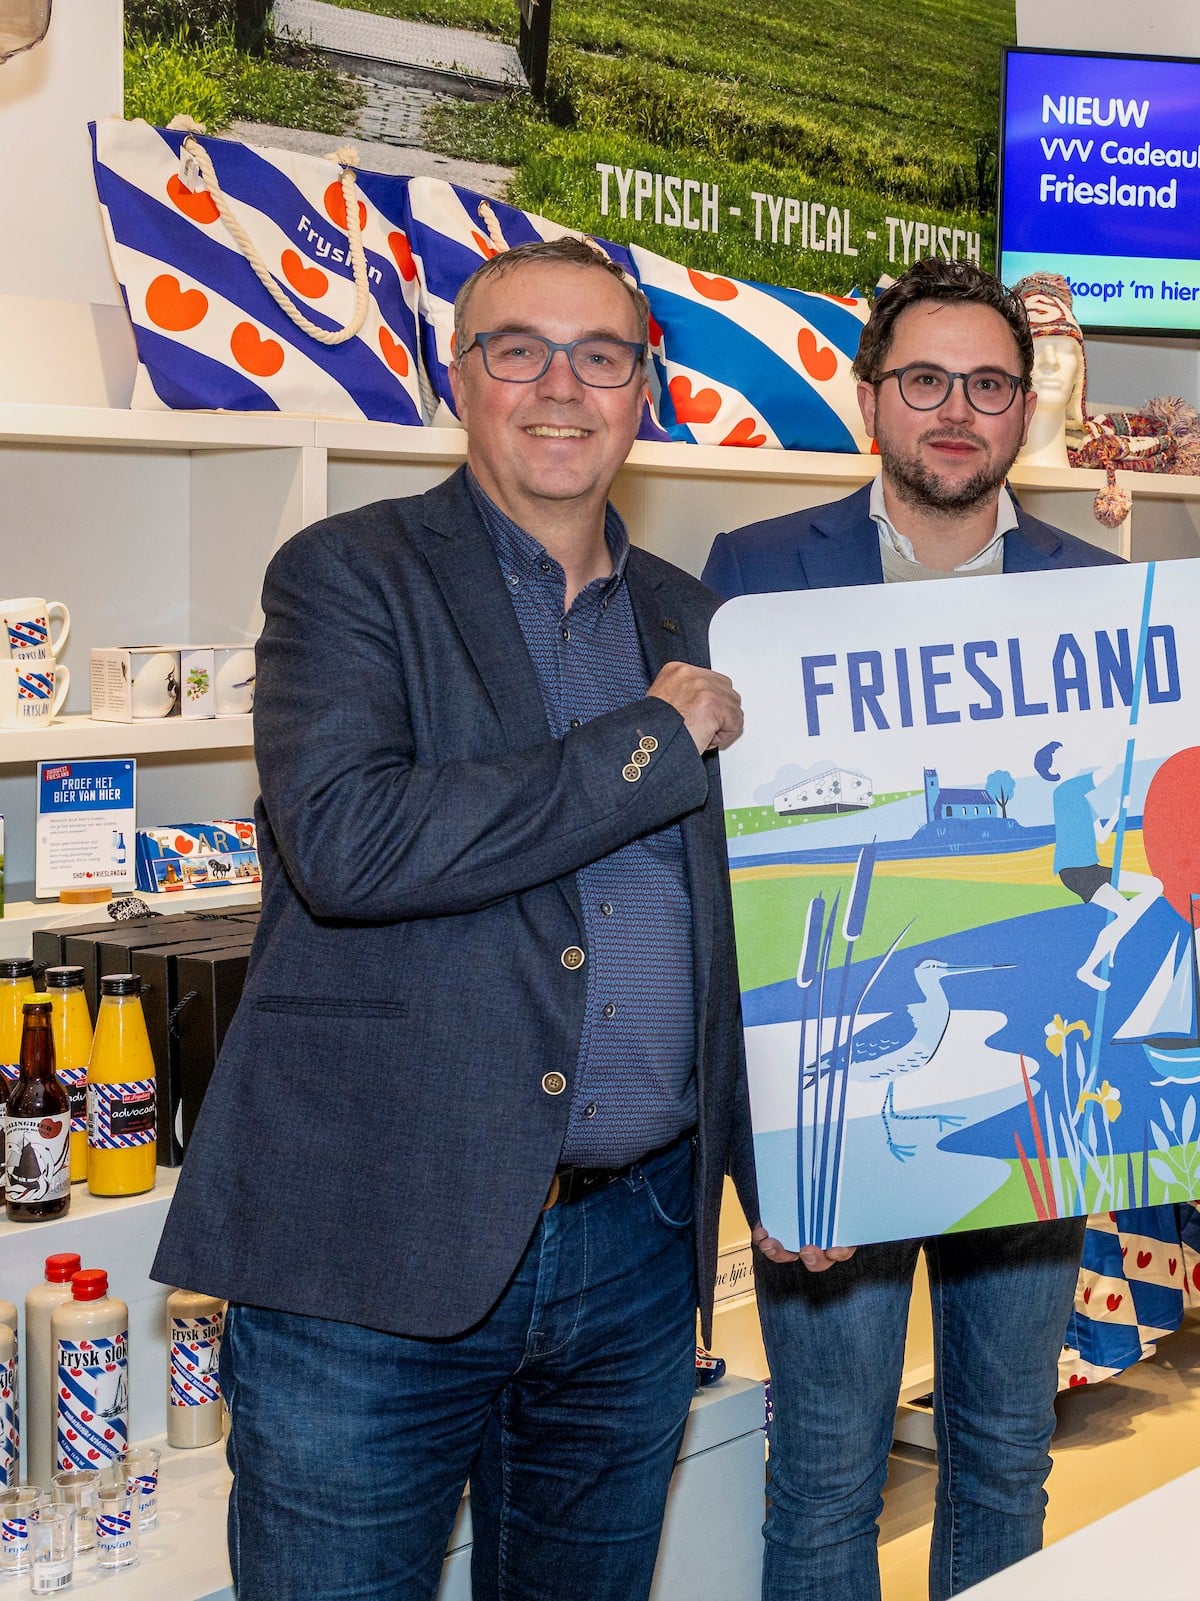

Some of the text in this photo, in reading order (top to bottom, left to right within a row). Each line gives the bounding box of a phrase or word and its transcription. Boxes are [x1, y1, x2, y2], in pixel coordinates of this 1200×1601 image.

[1041, 95, 1150, 129] NIEUW
[1040, 137, 1094, 163] VVV
[1039, 174, 1177, 209] Friesland
[596, 163, 719, 234] TYPISCH
[751, 191, 858, 257] TYPICAL
[885, 216, 981, 269] TYPISCH
[297, 215, 383, 285] Frysln
[800, 624, 1182, 737] FRIESLAND
[54, 788, 121, 803] BIER VAN HIER
[62, 776, 113, 791] PROEF HET
[172, 1328, 199, 1343] Frysk
[60, 1349, 100, 1369] Frysk
